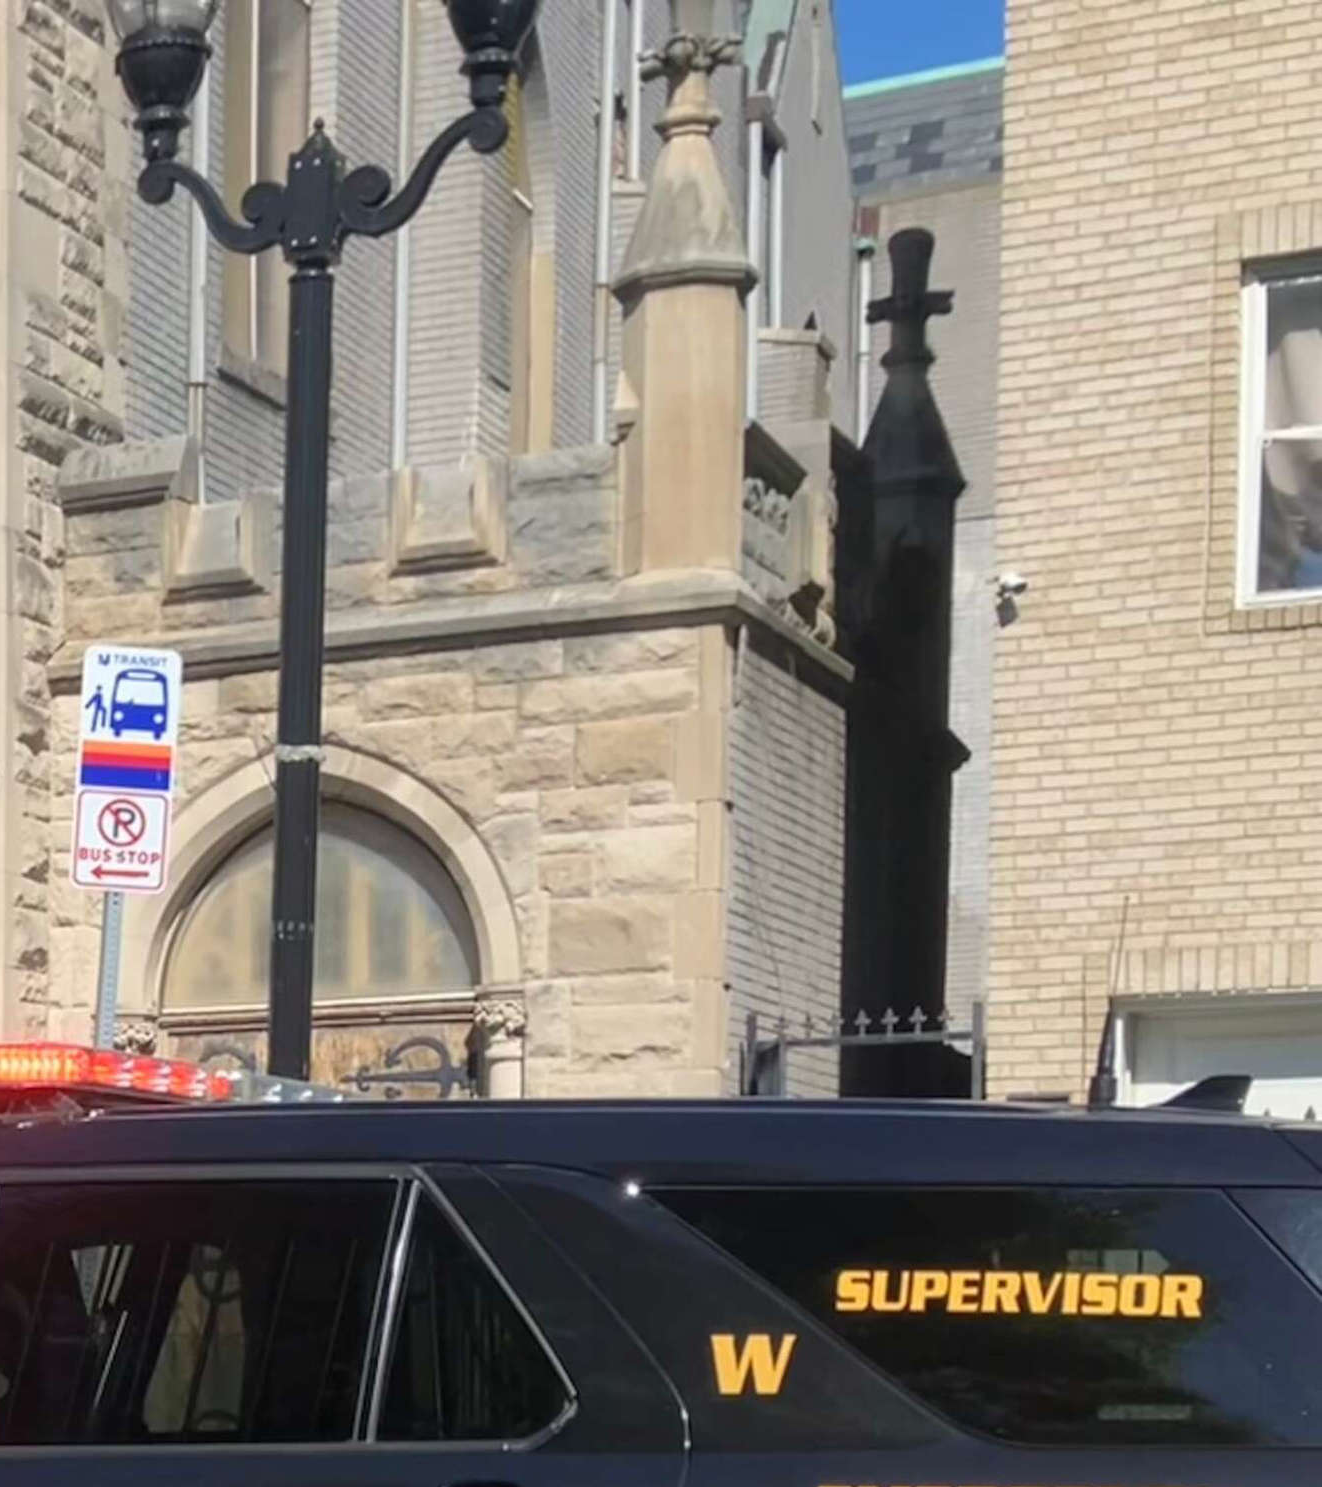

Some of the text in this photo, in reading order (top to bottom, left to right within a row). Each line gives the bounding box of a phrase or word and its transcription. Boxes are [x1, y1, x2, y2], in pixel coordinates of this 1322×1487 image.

[113, 654, 167, 667] TRANSIT
[79, 847, 160, 864] BUS STOP
[835, 1268, 1204, 1319] SUPERVISOR
[710, 1333, 797, 1395] W
